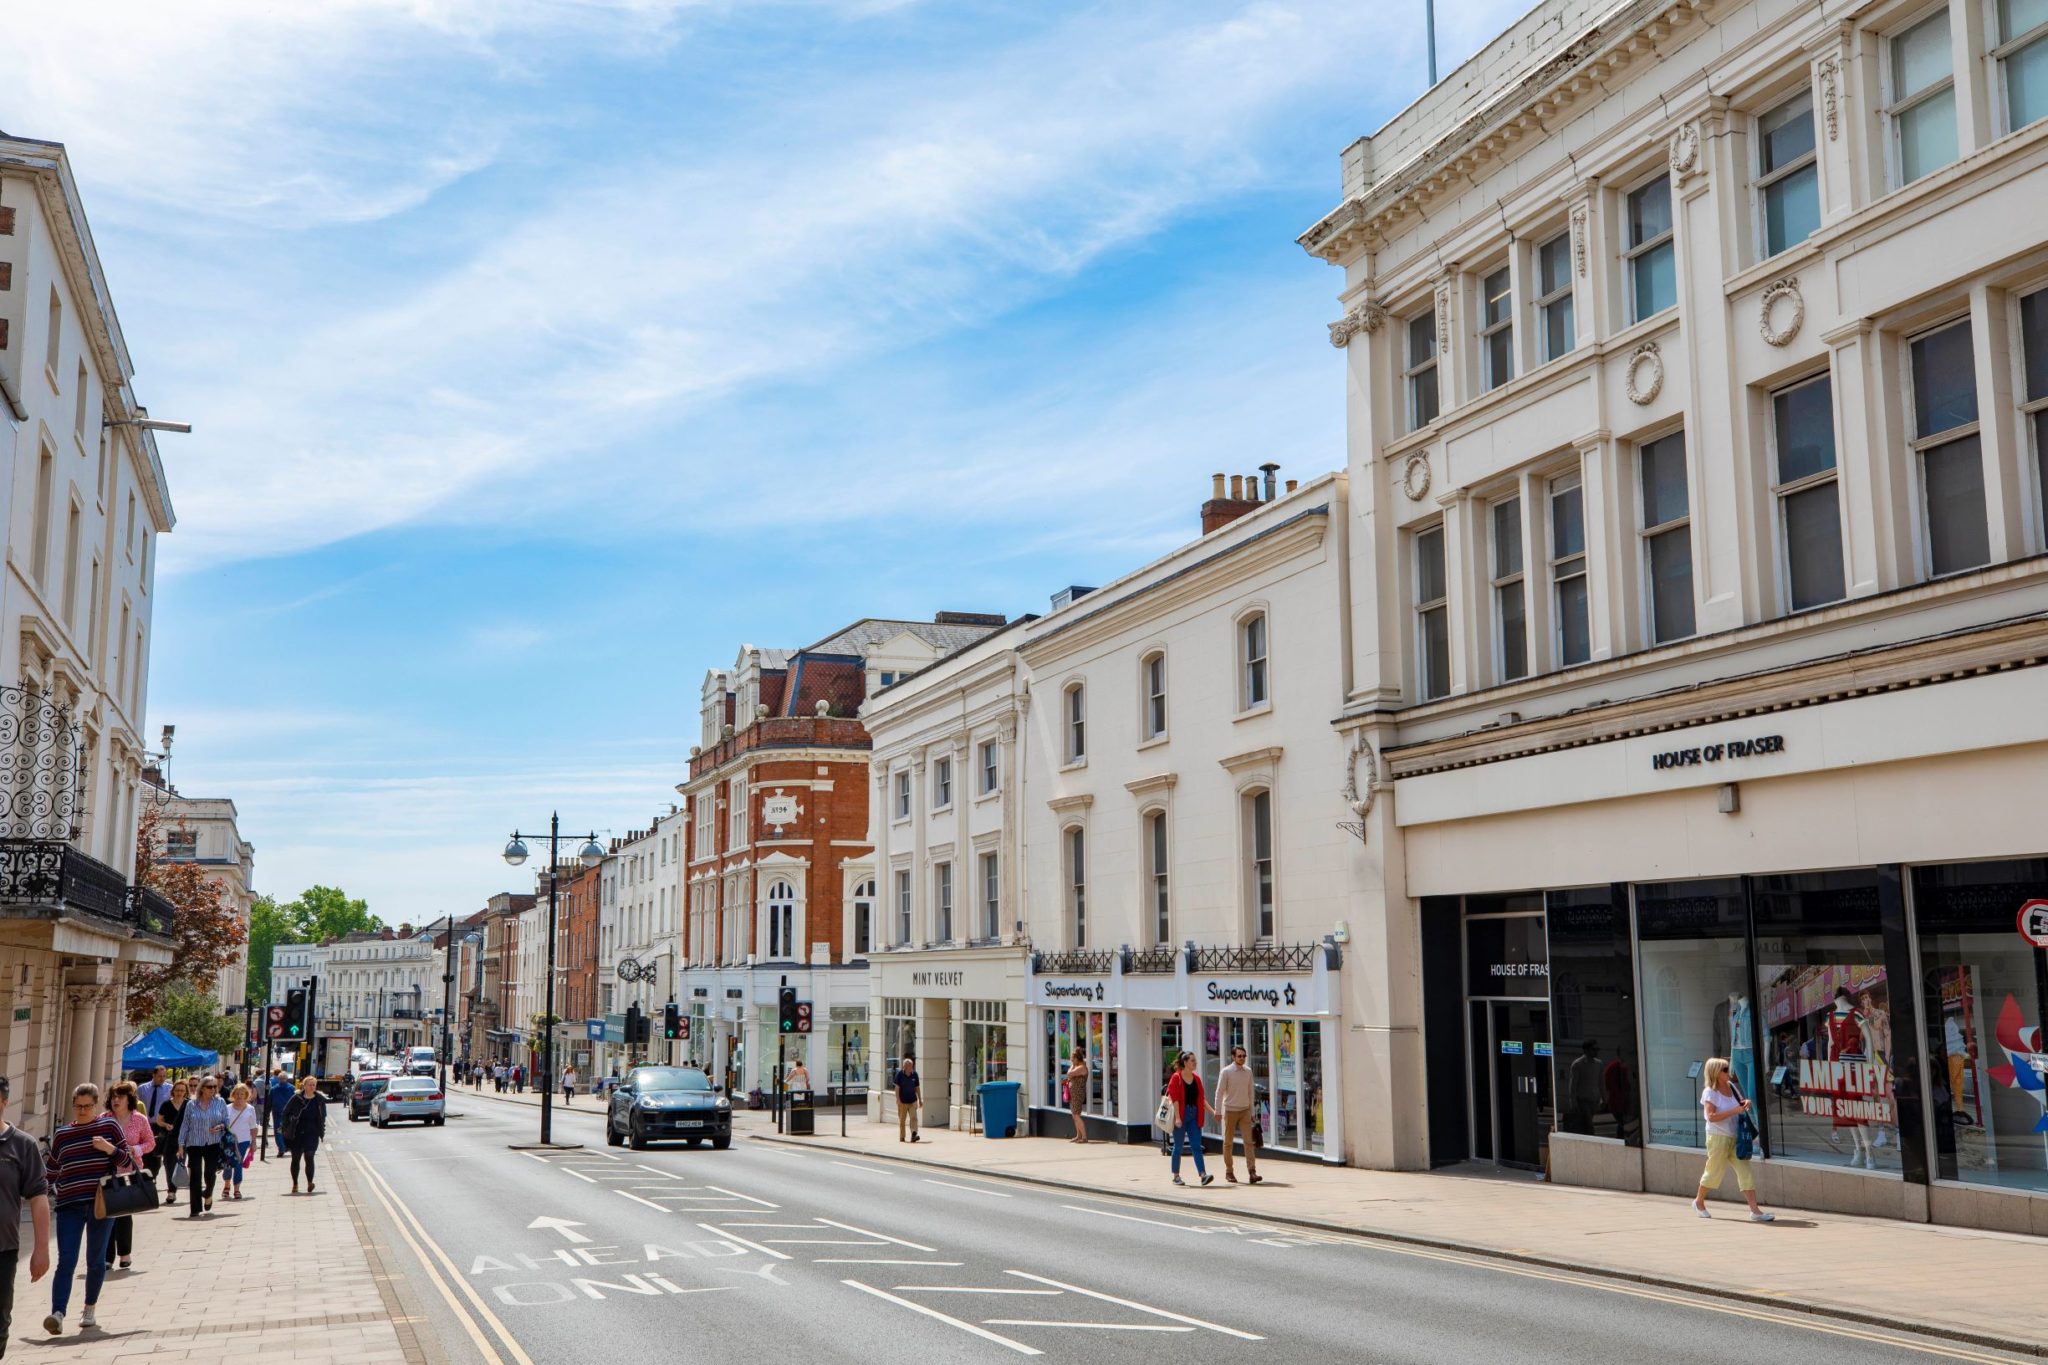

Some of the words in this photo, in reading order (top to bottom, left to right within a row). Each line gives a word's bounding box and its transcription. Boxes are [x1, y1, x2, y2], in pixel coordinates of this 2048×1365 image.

[1653, 748, 1701, 770] HOUSE
[1703, 744, 1724, 762] OF
[1727, 735, 1784, 760] FRASER
[912, 972, 932, 986] MINT
[934, 971, 963, 986] VELVET
[1490, 964, 1517, 976] HOUSE
[1517, 964, 1529, 976] OF
[1044, 981, 1093, 1002] Superdrug
[1207, 981, 1279, 1007] Superdrug
[1799, 1059, 1887, 1097] AMPLIFY
[1800, 1095, 1833, 1117] YOUR
[1836, 1098, 1891, 1122] SUMMER
[470, 1240, 750, 1275] AHEAD
[492, 1263, 792, 1306] ONLY
